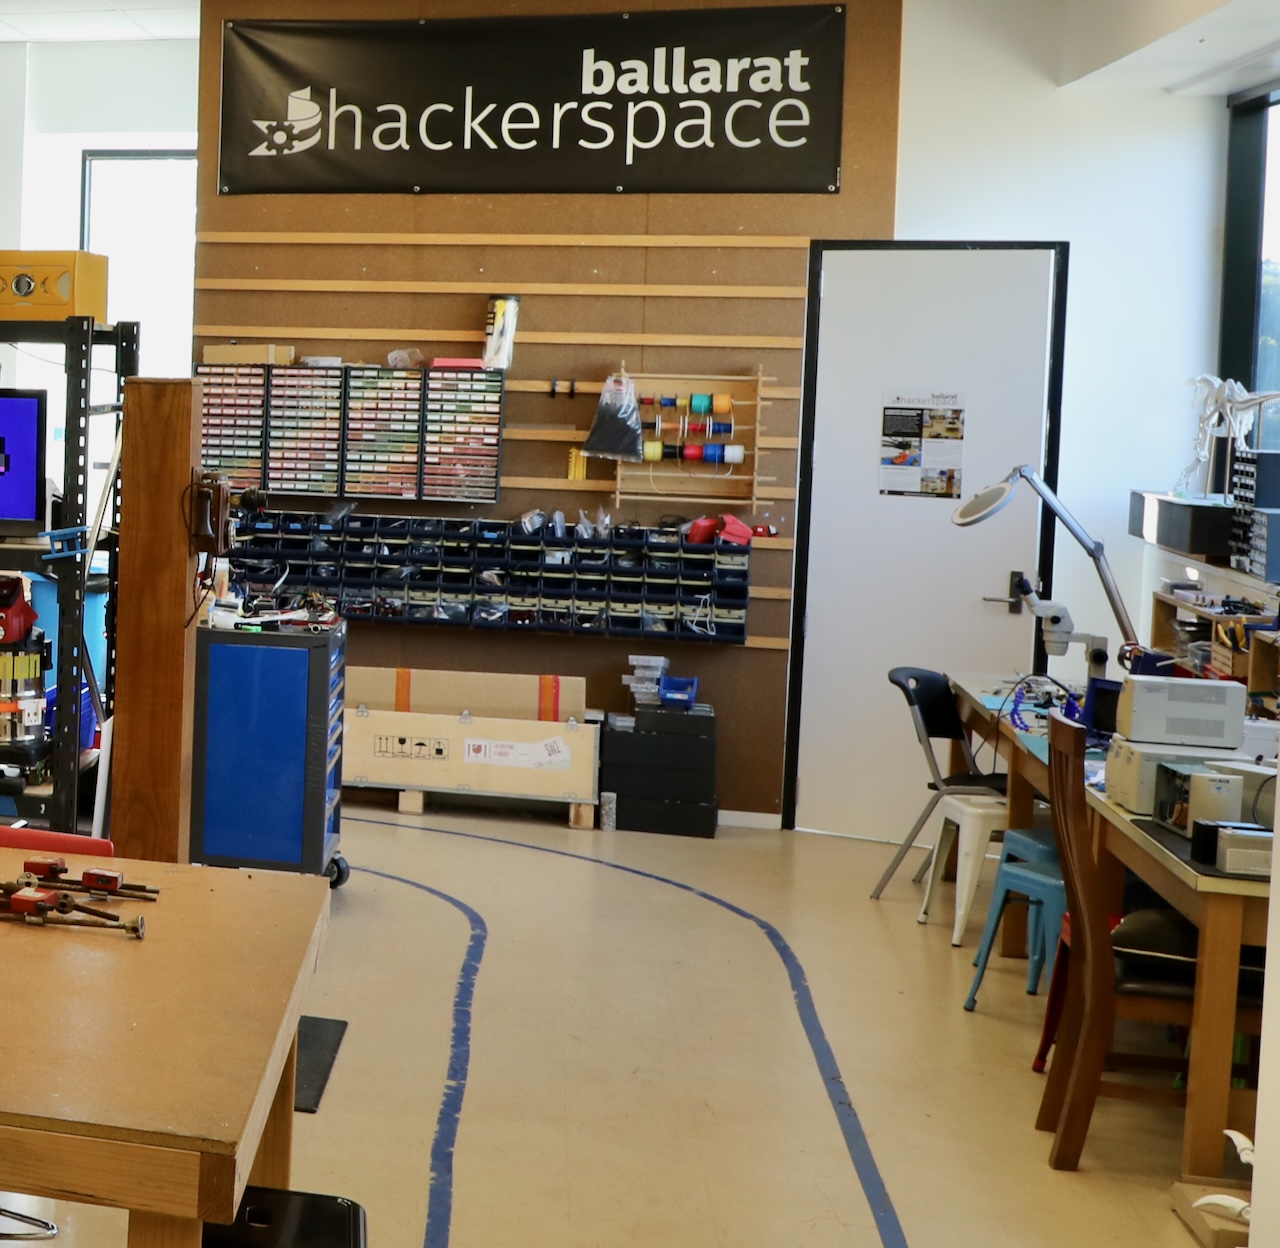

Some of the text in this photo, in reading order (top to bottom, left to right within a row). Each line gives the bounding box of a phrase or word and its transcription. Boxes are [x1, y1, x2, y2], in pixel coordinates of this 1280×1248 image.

[581, 46, 811, 95] ballarat
[328, 85, 811, 166] hackerspace
[900, 396, 958, 406] hackerspace
